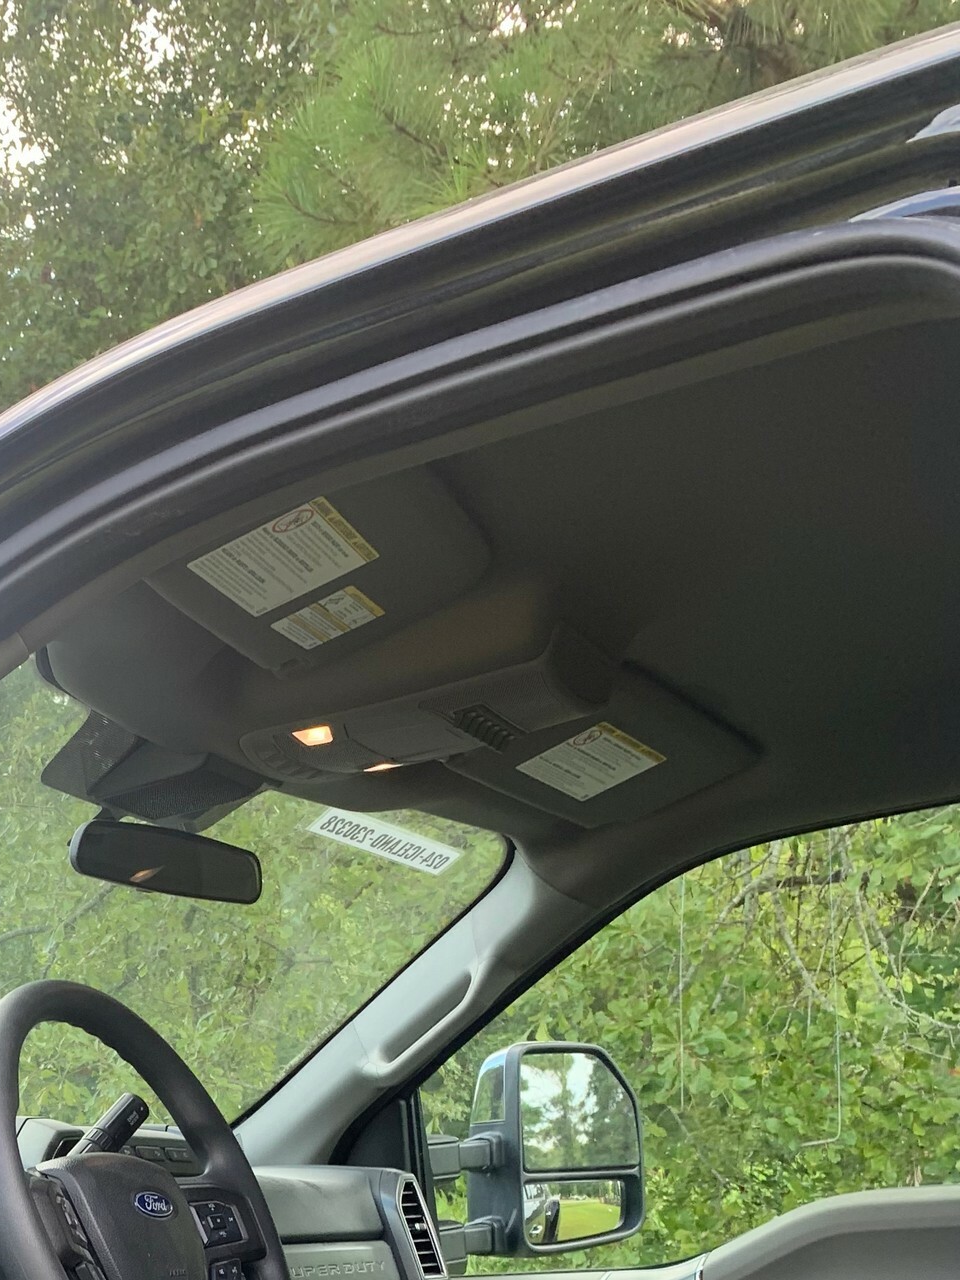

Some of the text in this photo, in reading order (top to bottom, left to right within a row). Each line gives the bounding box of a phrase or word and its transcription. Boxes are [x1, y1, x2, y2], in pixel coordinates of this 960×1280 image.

[144, 1194, 169, 1211] Ford
[290, 1261, 385, 1278] UPER DUTY
